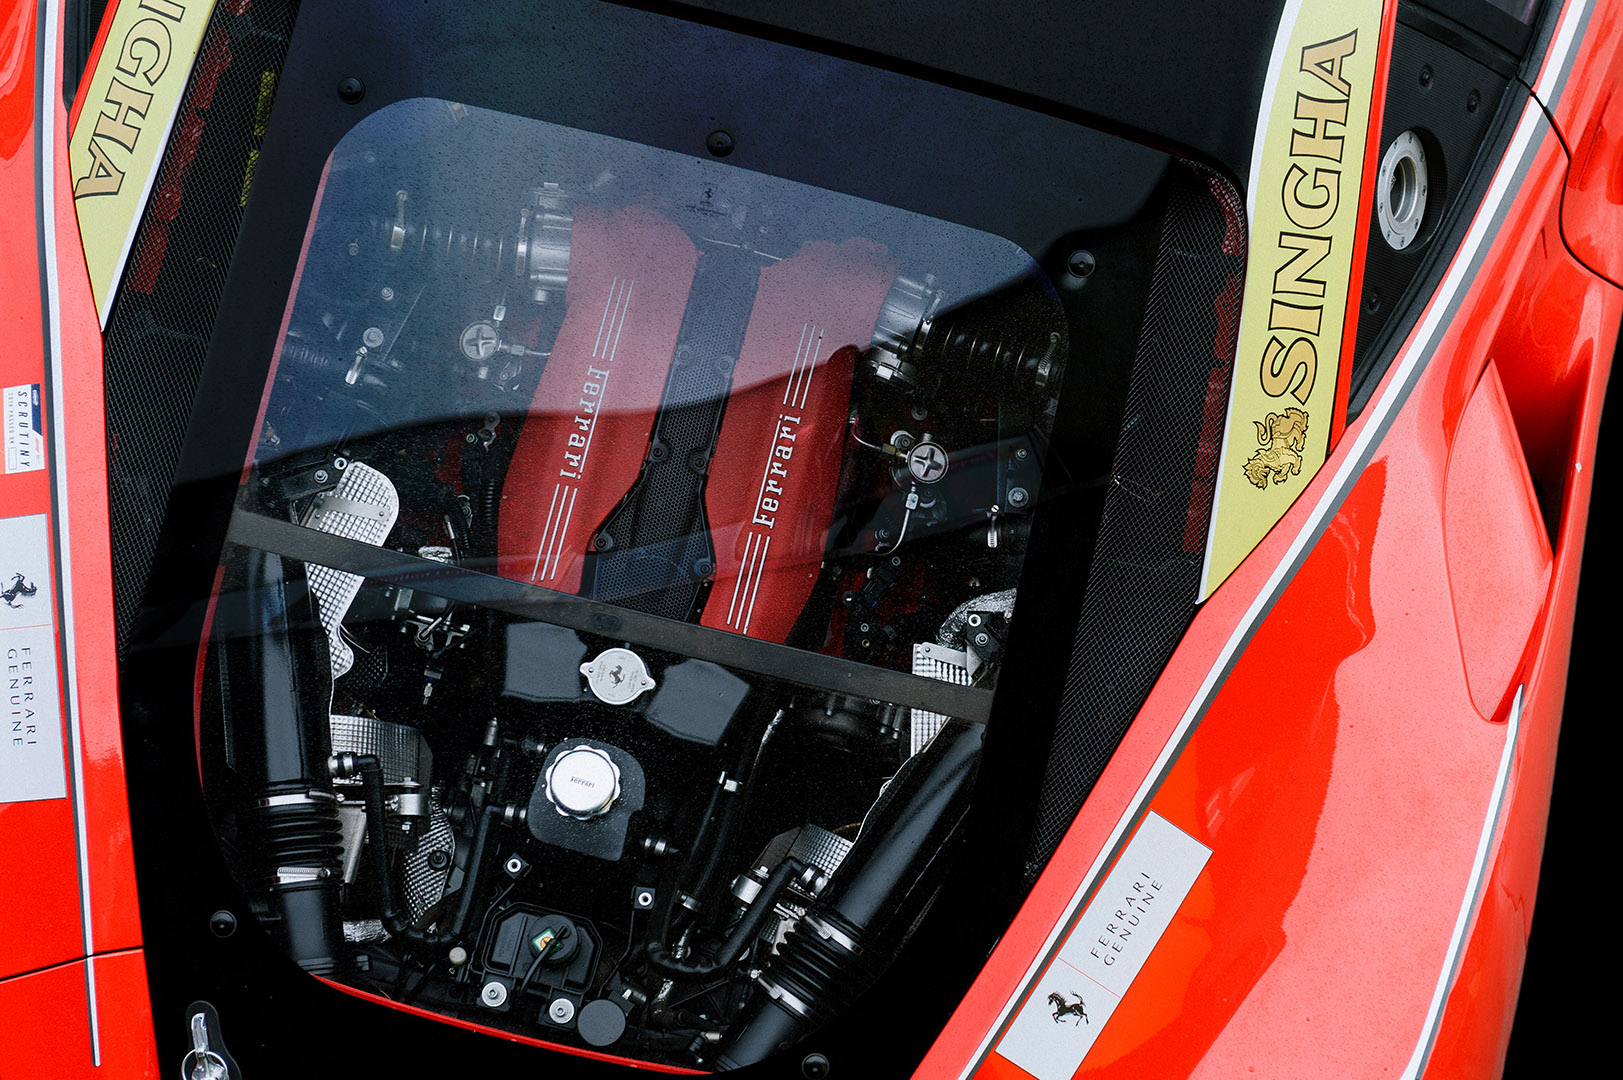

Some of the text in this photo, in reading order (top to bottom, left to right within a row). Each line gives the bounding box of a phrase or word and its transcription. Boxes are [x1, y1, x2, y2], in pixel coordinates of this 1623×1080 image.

[1259, 28, 1358, 406] SINGHA
[18, 390, 31, 467] SCRUTINY
[560, 365, 610, 480] Ferrari
[752, 413, 801, 529] Ferrari
[7, 648, 23, 746] GENUINE
[21, 647, 37, 744] FERRARI
[570, 776, 595, 788] Ferrari
[1090, 872, 1150, 959] FERRARI
[1103, 880, 1163, 966] GENUINE
